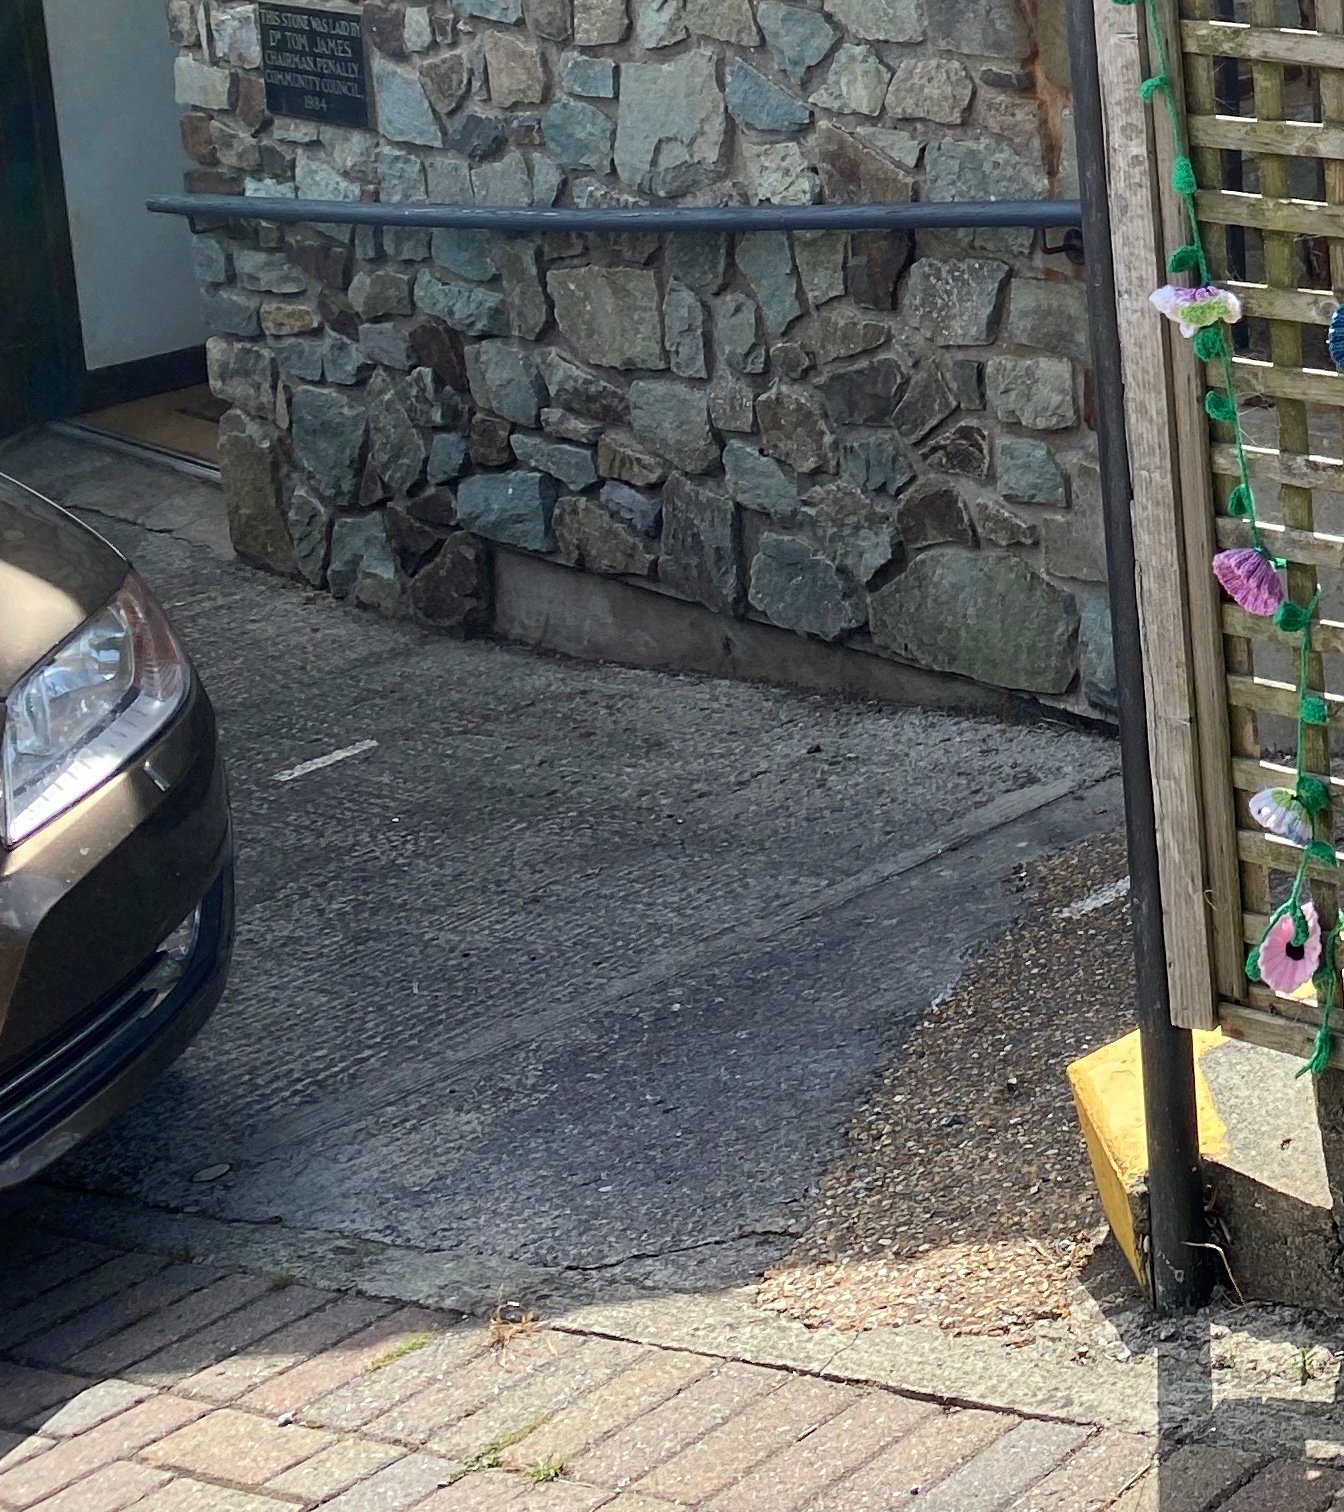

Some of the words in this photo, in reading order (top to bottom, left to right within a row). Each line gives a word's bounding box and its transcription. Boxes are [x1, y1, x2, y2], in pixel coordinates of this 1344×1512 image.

[281, 13, 310, 30] STONE
[285, 31, 309, 51] TOM
[313, 38, 352, 57] JAMES
[316, 57, 359, 78] PENALLY
[265, 70, 321, 92] COMMUNITY
